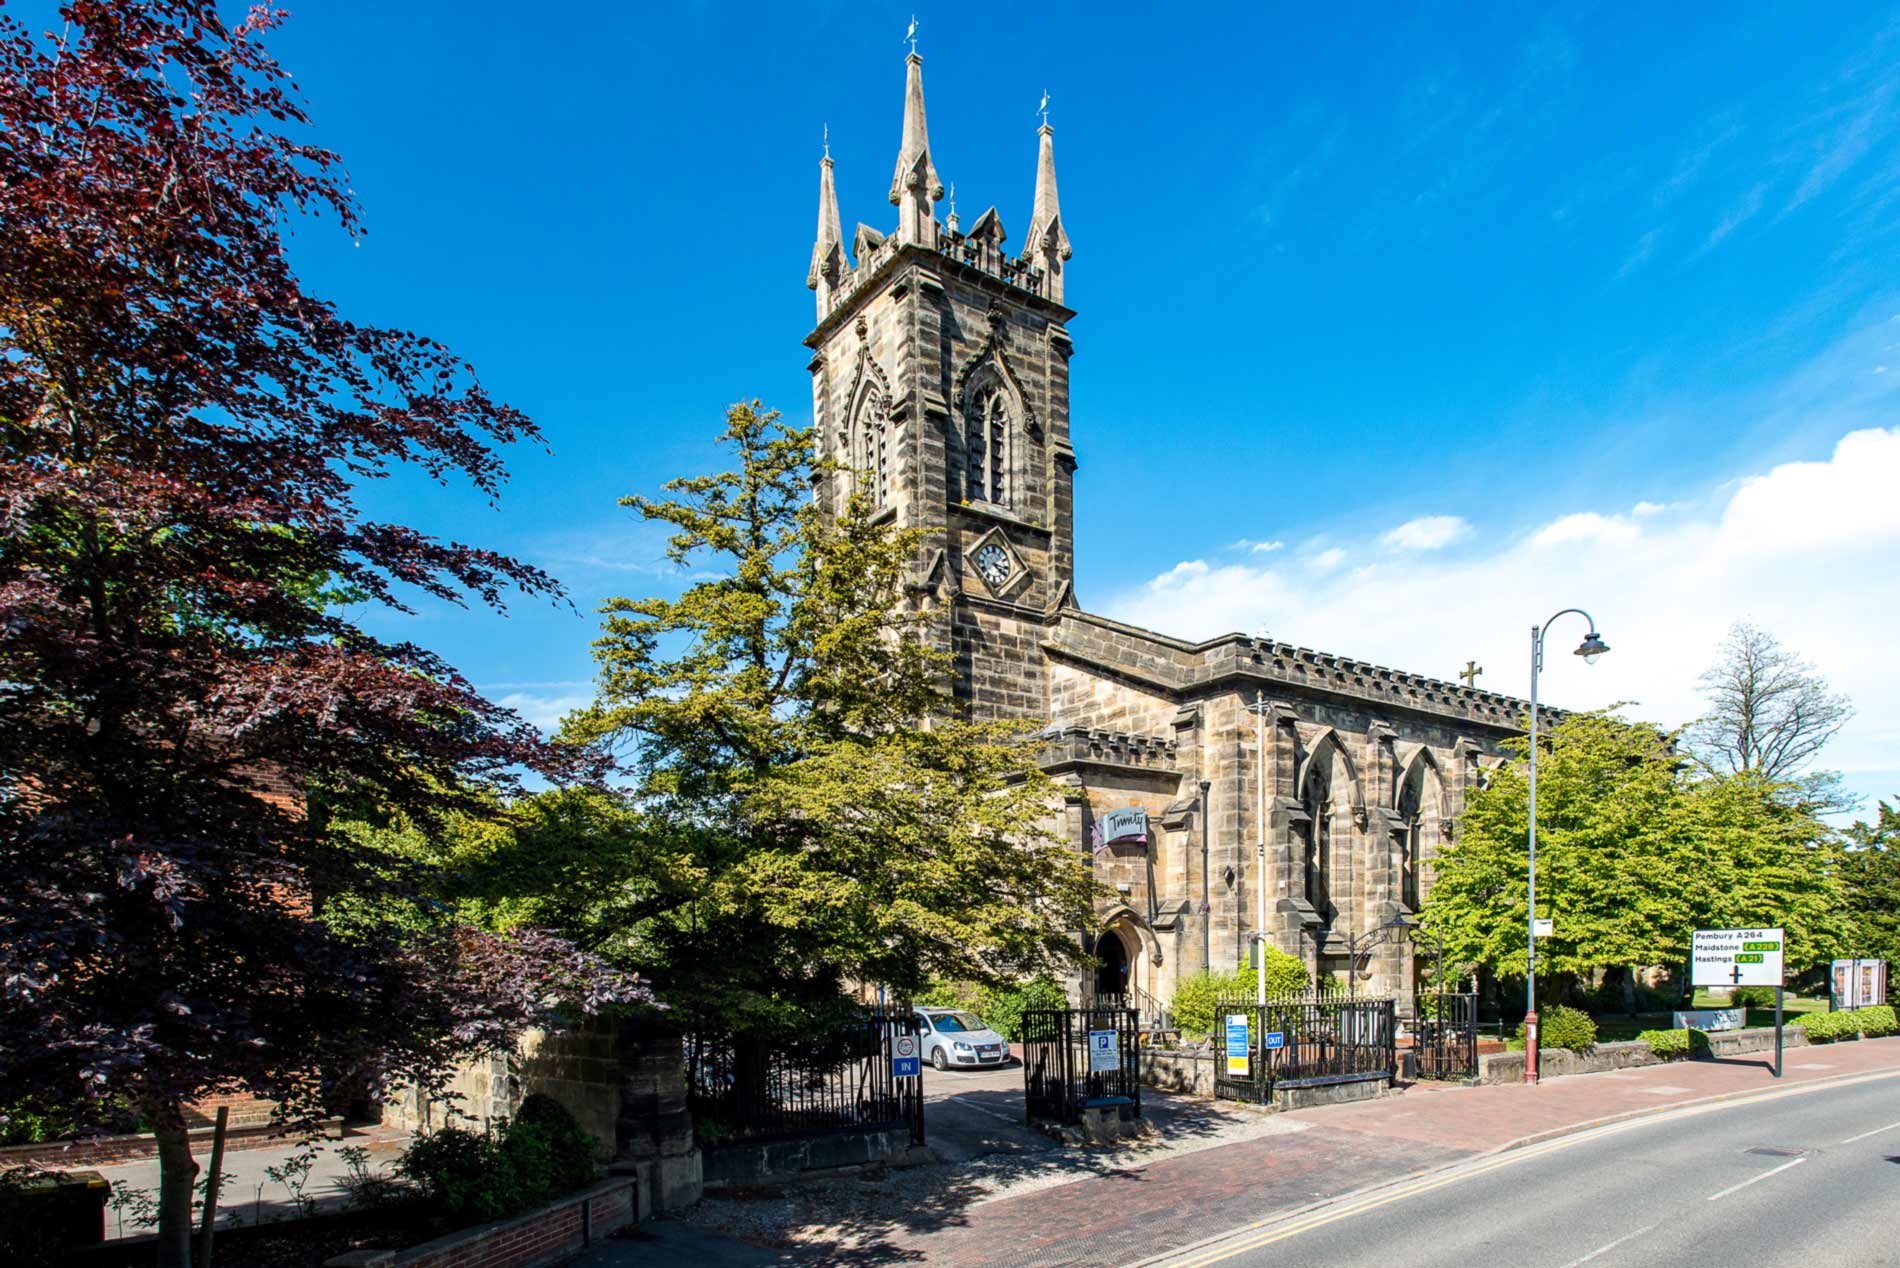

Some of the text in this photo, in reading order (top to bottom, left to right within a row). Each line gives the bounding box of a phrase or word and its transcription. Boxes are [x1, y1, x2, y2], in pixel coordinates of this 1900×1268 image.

[1110, 812, 1143, 832] Trinity
[1268, 1036, 1281, 1044] OUT
[901, 1062, 911, 1071] IN
